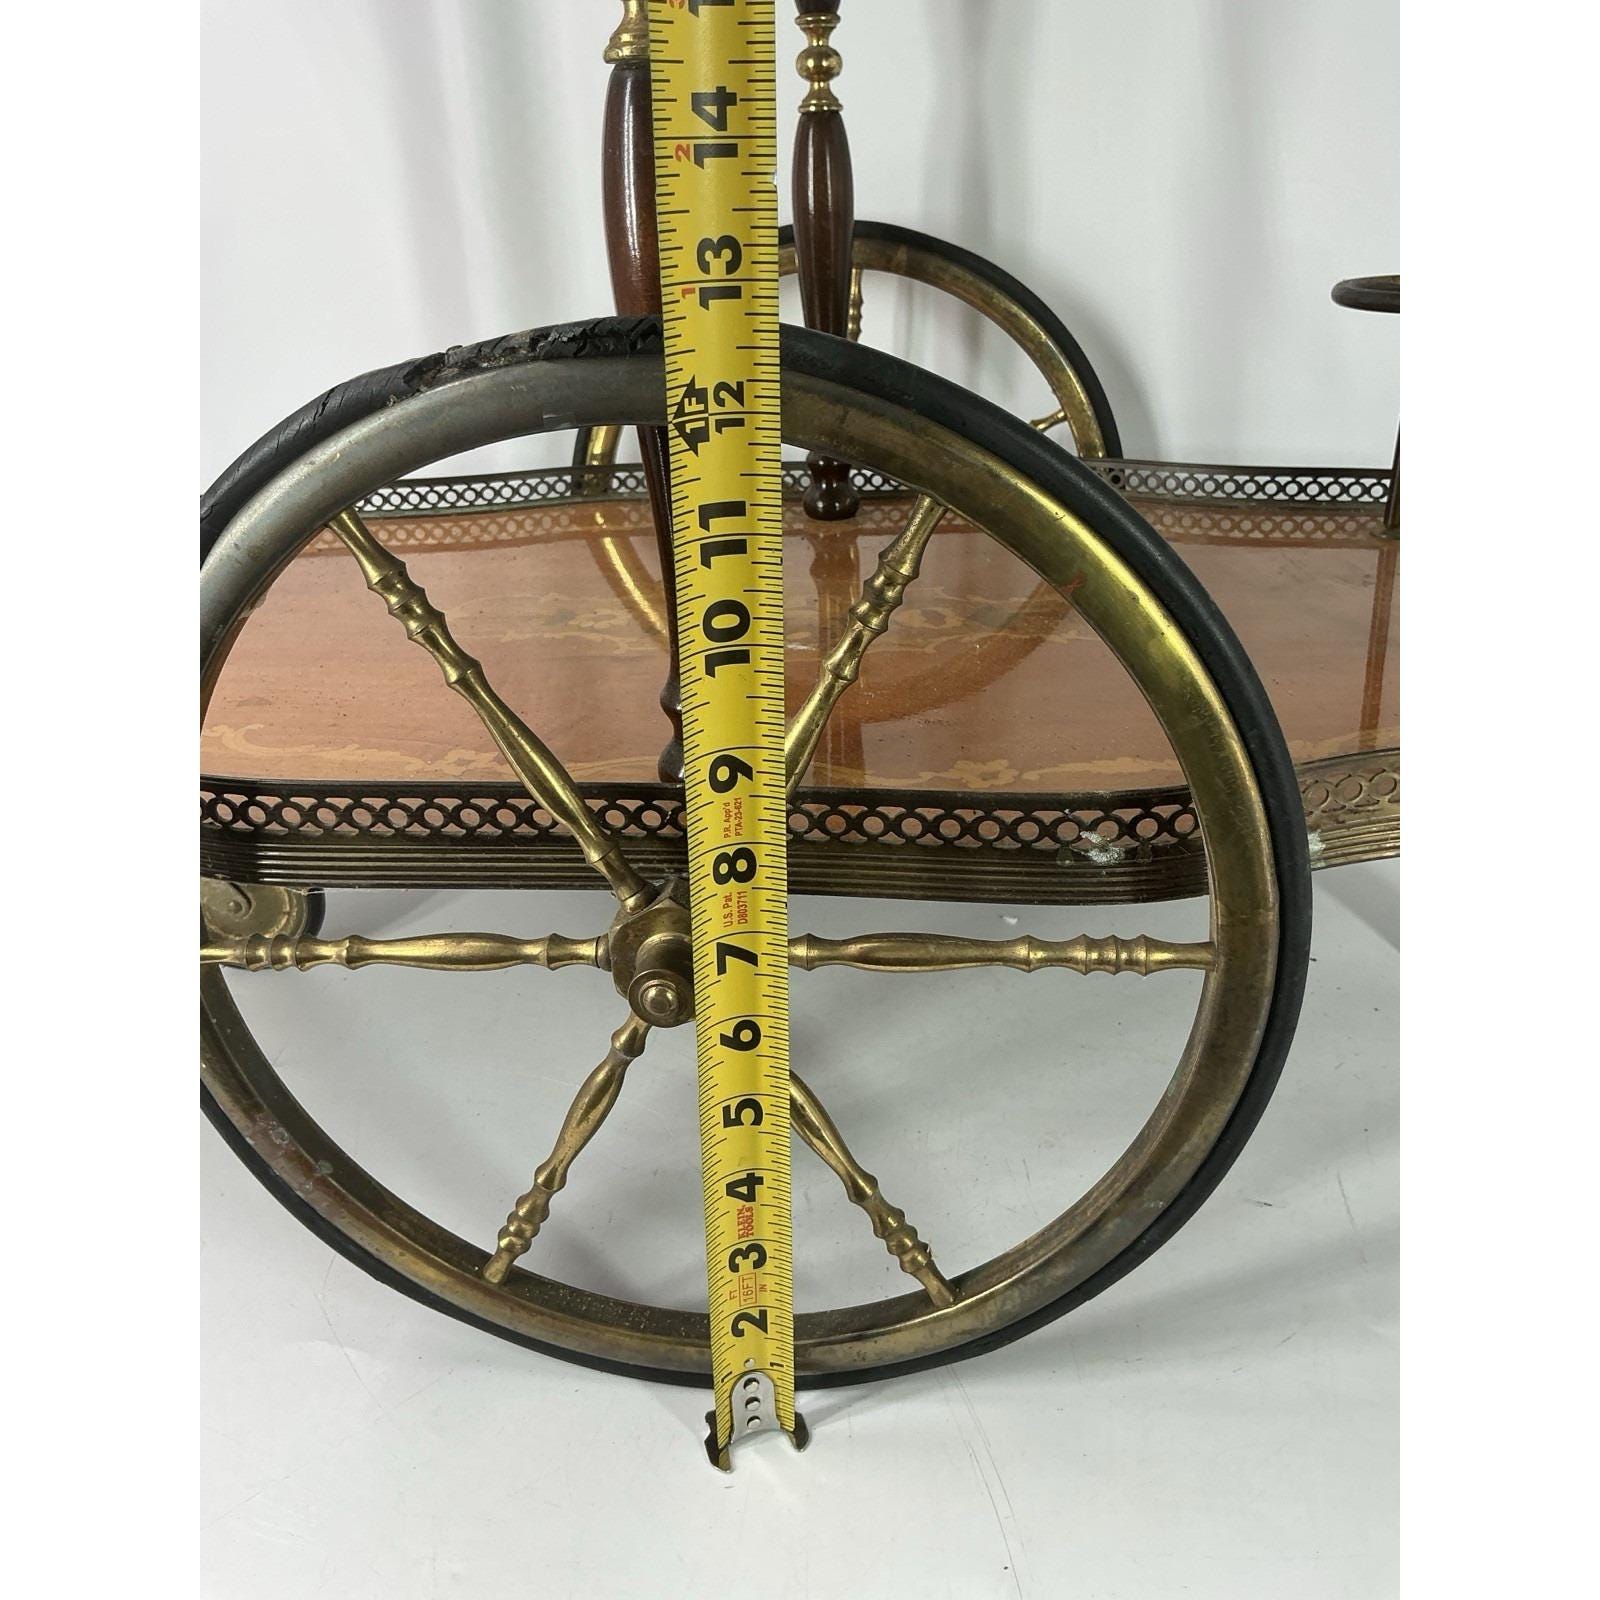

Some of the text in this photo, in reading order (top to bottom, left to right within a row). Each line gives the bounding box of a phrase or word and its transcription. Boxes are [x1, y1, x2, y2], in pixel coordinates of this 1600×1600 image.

[691, 86, 739, 170] 14
[675, 144, 691, 163] 2
[697, 235, 743, 311] 13
[681, 287, 696, 299] 1
[713, 381, 745, 435] 12
[698, 500, 748, 570] 11
[702, 599, 751, 679] 10
[708, 754, 754, 794] 9
[712, 847, 757, 886] 8
[722, 892, 734, 928] U.S. Pat.
[736, 891, 748, 925] D803711
[716, 941, 759, 977] 7
[719, 1019, 762, 1052] 6
[722, 1097, 764, 1129] 5
[725, 1172, 764, 1203] 4
[736, 1207, 746, 1240] KLEIN
[744, 1206, 754, 1238] TOOLS
[728, 1242, 768, 1273] 3
[729, 1289, 738, 1300] FT
[758, 1283, 767, 1293] IN
[731, 1309, 768, 1338] 2
